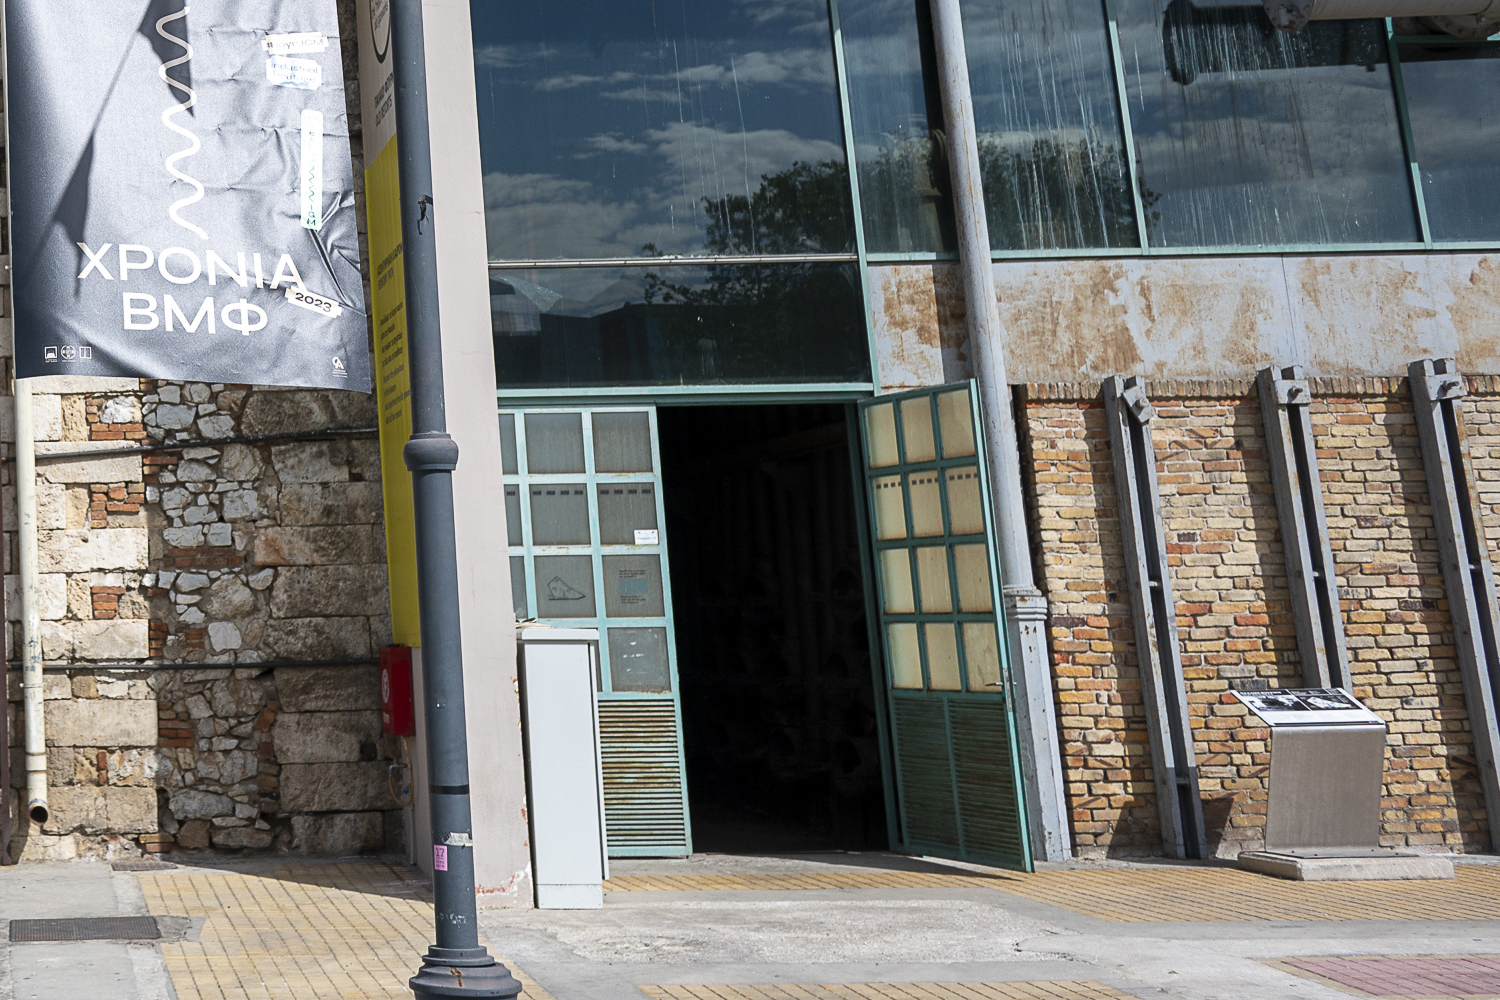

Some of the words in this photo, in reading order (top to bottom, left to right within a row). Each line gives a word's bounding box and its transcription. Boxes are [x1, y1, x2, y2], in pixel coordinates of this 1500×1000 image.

[76, 242, 307, 292] ΧΡΟΝΙΑ
[122, 291, 268, 336] ΒΜΦ
[295, 292, 332, 313] 2023
[435, 847, 445, 857] 17
